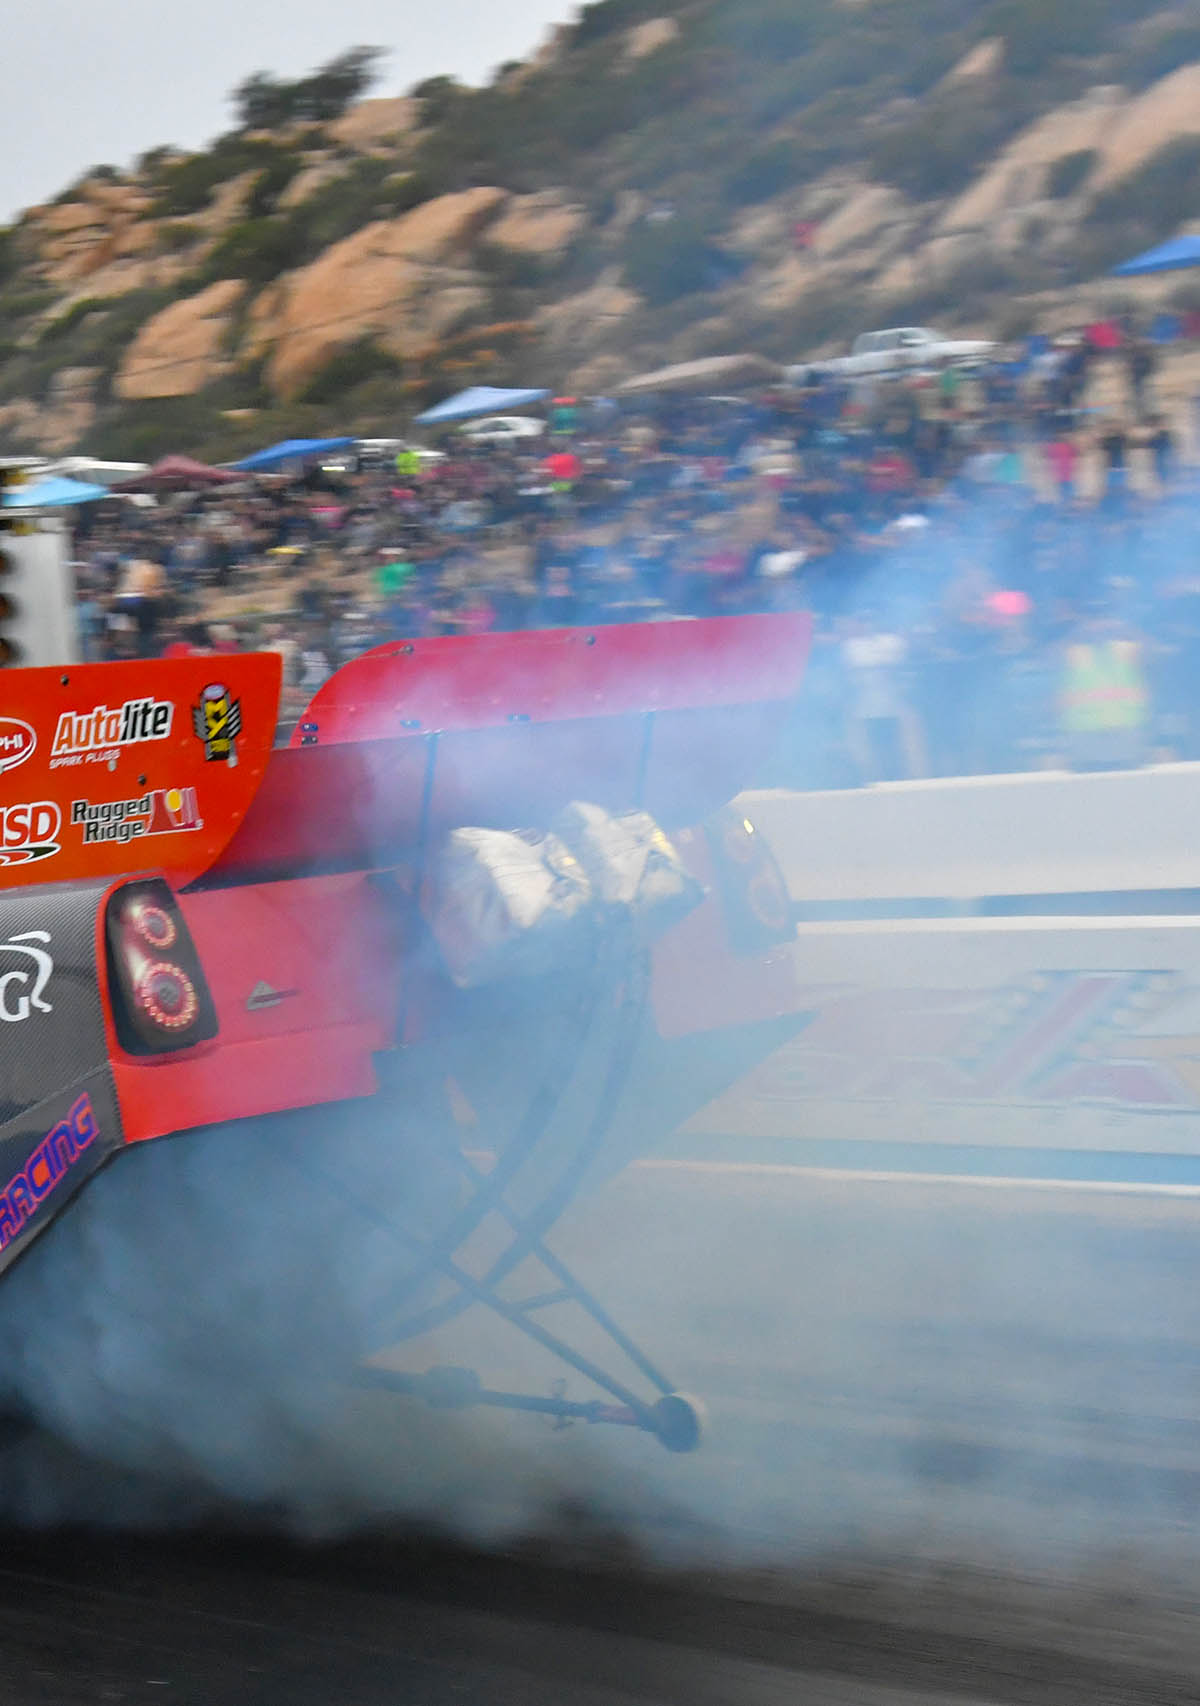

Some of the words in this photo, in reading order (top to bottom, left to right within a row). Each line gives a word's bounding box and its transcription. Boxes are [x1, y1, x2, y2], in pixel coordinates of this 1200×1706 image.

[53, 698, 173, 755] Autolite
[50, 755, 83, 769] SPARK
[85, 749, 121, 764] PLUGS
[72, 795, 152, 825] Rugged
[84, 818, 147, 845] Ridge
